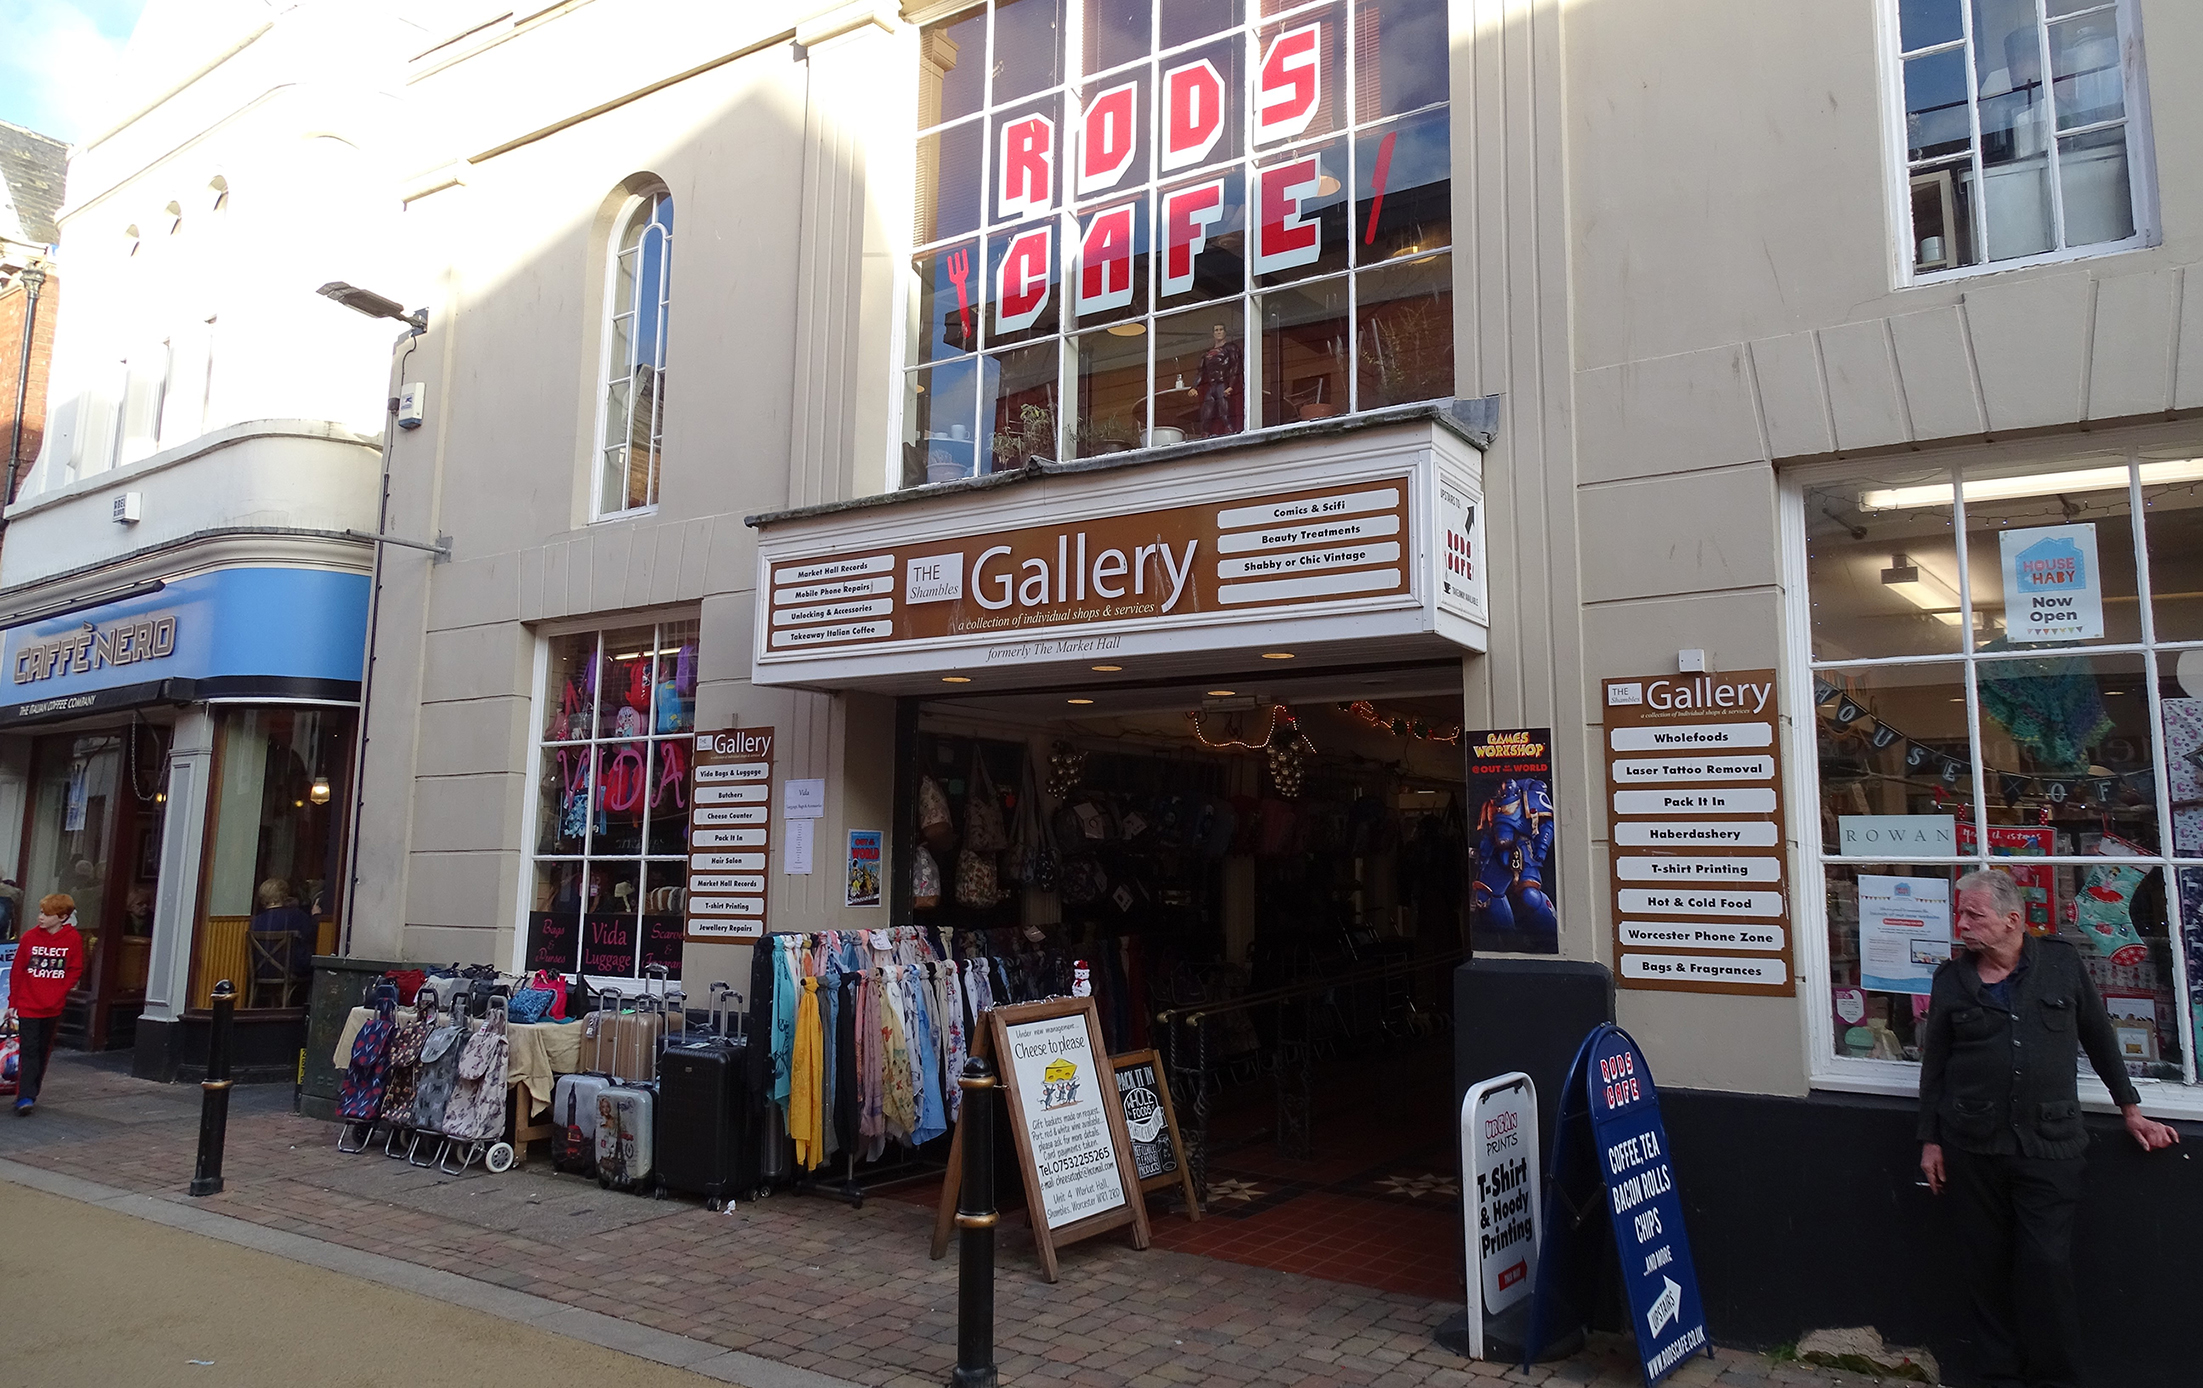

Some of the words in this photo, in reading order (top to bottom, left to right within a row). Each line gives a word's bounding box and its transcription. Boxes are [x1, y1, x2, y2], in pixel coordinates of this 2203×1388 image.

[998, 21, 1321, 218] RODS
[995, 153, 1321, 335] CAFE
[1273, 506, 1308, 517] Comics
[1311, 504, 1319, 513] &
[1322, 500, 1346, 511] Scifi
[1262, 533, 1298, 544] Beauty
[1300, 525, 1361, 539] Treatments
[1244, 560, 1282, 571] Shabby
[1285, 559, 1297, 567] or
[1299, 554, 1321, 565] Chic
[1323, 551, 1366, 563] Vintage
[2023, 557, 2075, 572] HOUSE
[797, 569, 823, 579] Market
[824, 566, 839, 575] Hall
[840, 562, 868, 572] Records
[913, 564, 940, 582] THE
[971, 532, 1198, 613] Gallery
[2032, 570, 2075, 585] HABY
[795, 588, 819, 598] Mobile
[820, 586, 842, 596] Phone
[843, 584, 870, 594] Repairs
[909, 583, 959, 600] Shambles
[2032, 597, 2073, 608] Now
[791, 609, 825, 620] Unlocking
[833, 605, 872, 615] Accessories
[958, 622, 964, 631] a
[966, 616, 1010, 630] collection
[1011, 613, 1024, 628] of
[1024, 608, 1071, 624] individual
[1072, 607, 1100, 621] shops
[1102, 604, 1112, 617] &
[1114, 602, 1155, 616] services
[2030, 611, 2078, 623] Open
[94, 615, 177, 669] NERO
[790, 631, 825, 641] Takeaway
[826, 628, 850, 637] Italian
[852, 626, 876, 635] Coffee
[986, 645, 1031, 662] formerly
[1034, 642, 1053, 655] The
[1056, 640, 1094, 653] Market
[1096, 636, 1121, 650] Hall
[1610, 696, 1640, 704] Shambles
[1612, 687, 1629, 696] THE
[1646, 676, 1772, 714] Gallery
[19, 705, 29, 716] THE
[29, 702, 48, 714] ITALIAN
[47, 699, 68, 711] COFFEE
[67, 695, 97, 708] COMPANY
[714, 731, 771, 757] Gallery
[1487, 731, 1530, 745] GAMES
[1653, 731, 1729, 744] Wholefoods
[1473, 743, 1545, 758] WORKSHOP
[715, 770, 728, 778] Bags
[736, 769, 762, 777] Luggage
[1513, 763, 1548, 772] WORLD
[1626, 766, 1659, 776] Laser
[1662, 765, 1702, 775] Tattoo
[1706, 763, 1762, 774] Removal
[556, 744, 685, 812] VIDA
[1664, 797, 1694, 807] Pack
[1698, 797, 1708, 806] It
[1712, 796, 1725, 806] In
[1649, 828, 1741, 841] Haberdashery
[1845, 828, 1949, 843] ROWAN
[851, 847, 880, 860] WORLD
[1651, 864, 1692, 874] T-shirt
[1695, 864, 1748, 876] Printing
[725, 902, 749, 911] Printing
[1647, 897, 1670, 907] Hot
[1673, 898, 1684, 907] &
[1688, 897, 1716, 908] Cold
[1720, 898, 1752, 909] Food
[542, 918, 565, 938] Bags
[591, 919, 628, 945] Vida
[699, 924, 728, 932] Jewellery
[729, 924, 752, 932] Repairs
[1628, 929, 1691, 941] Worcester
[1695, 931, 1736, 942] Phone
[1739, 932, 1774, 943] Zone
[32, 945, 69, 957] SELECT
[585, 948, 632, 972] Luggage
[1642, 961, 1672, 974] Bags
[1676, 962, 1686, 972] &
[1690, 963, 1762, 976] Fragrances
[27, 967, 66, 979] PLAYER
[1015, 1042, 1047, 1059] Cheese
[1048, 1039, 1058, 1053] to
[1058, 1035, 1085, 1055] please
[1600, 1052, 1633, 1083] RODS
[1115, 1070, 1136, 1091] PACK
[1134, 1068, 1144, 1087] IT
[1143, 1066, 1155, 1085] IN
[1126, 1090, 1154, 1109] WHOLE
[1606, 1077, 1640, 1110] CAFE
[1132, 1105, 1152, 1119] FOODS
[1032, 1118, 1043, 1130] Gift
[1044, 1116, 1062, 1128] baskets
[1063, 1112, 1076, 1121] made
[1057, 1124, 1070, 1134] white
[1071, 1121, 1081, 1130] wine
[1485, 1111, 1517, 1139] URBAN
[1038, 1140, 1054, 1153] please
[1071, 1133, 1083, 1142] more
[1057, 1144, 1081, 1158] payments
[1486, 1132, 1518, 1156] PRINTS
[1639, 1130, 1661, 1160] TEA
[1477, 1157, 1527, 1203] T-Shirt
[1053, 1192, 1066, 1205] Unit
[1067, 1189, 1073, 1199] 4
[1075, 1184, 1095, 1197] Market
[1612, 1176, 1643, 1215] BACON
[1641, 1164, 1671, 1200] ROLLS
[1071, 1198, 1096, 1212] Worcester
[1480, 1206, 1490, 1230] &
[1492, 1187, 1528, 1223] Hoody
[1634, 1206, 1662, 1244] CHIPS
[1481, 1217, 1532, 1259] Printing
[1656, 1244, 1673, 1268] MORE
[1650, 1289, 1676, 1330] UPSTAIRS
